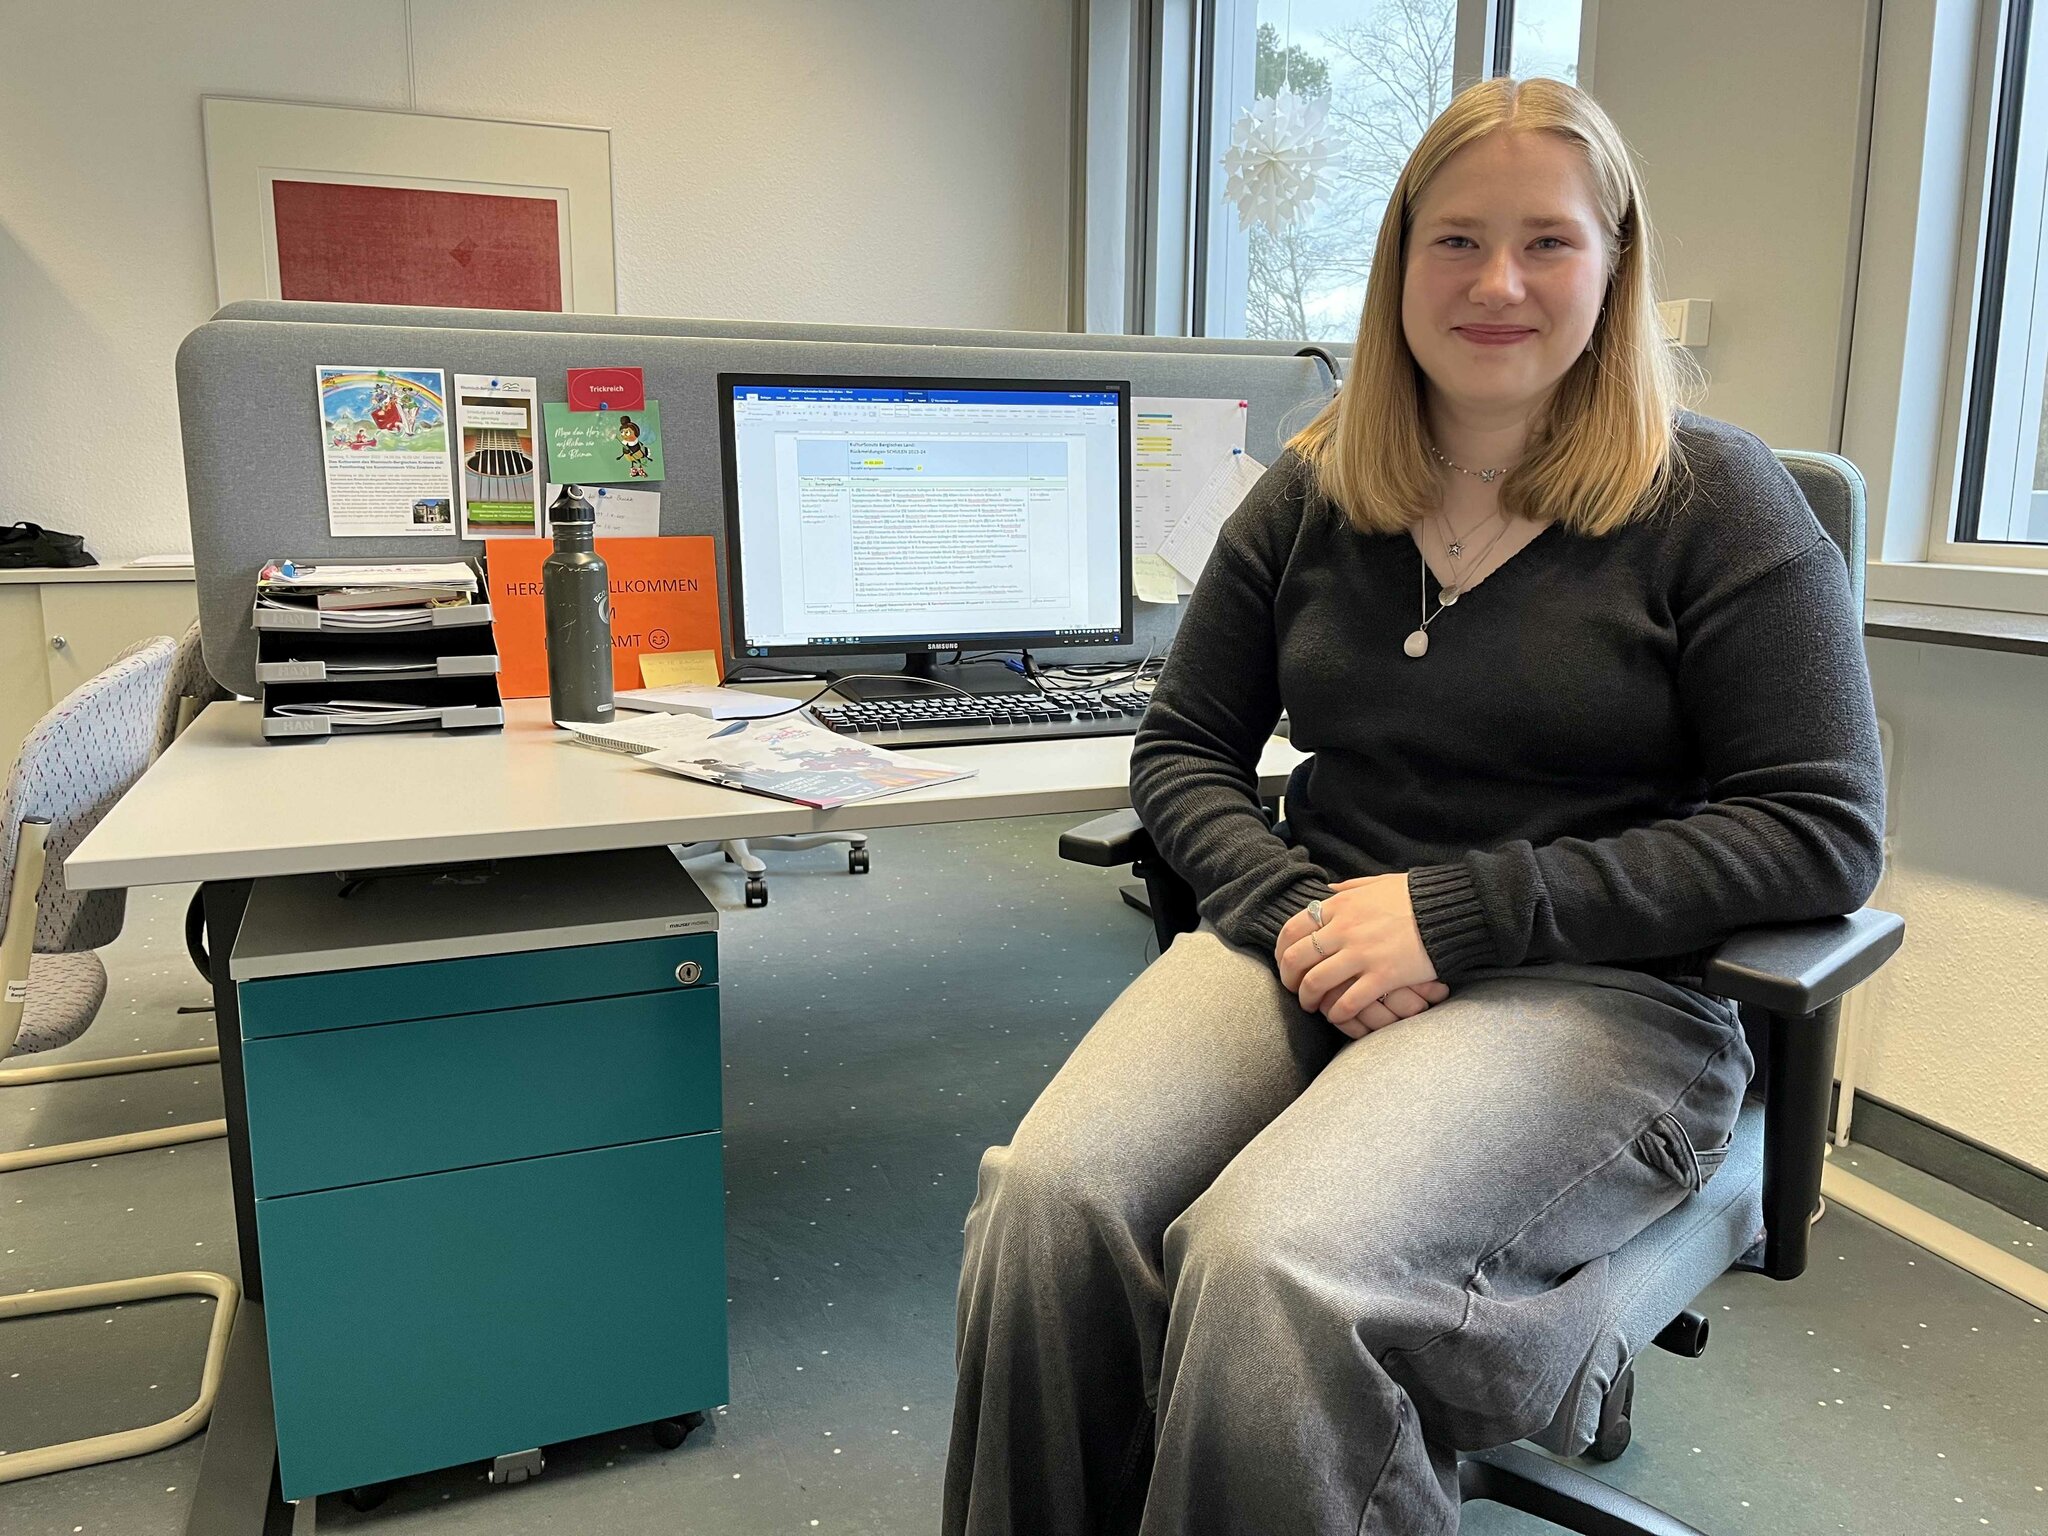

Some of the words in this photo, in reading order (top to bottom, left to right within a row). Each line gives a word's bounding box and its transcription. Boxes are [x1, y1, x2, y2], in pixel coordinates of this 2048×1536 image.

[589, 385, 624, 393] Trickreich
[506, 582, 544, 596] HERZ
[609, 578, 698, 593] LLKOMMEN
[283, 720, 314, 731] HAN
